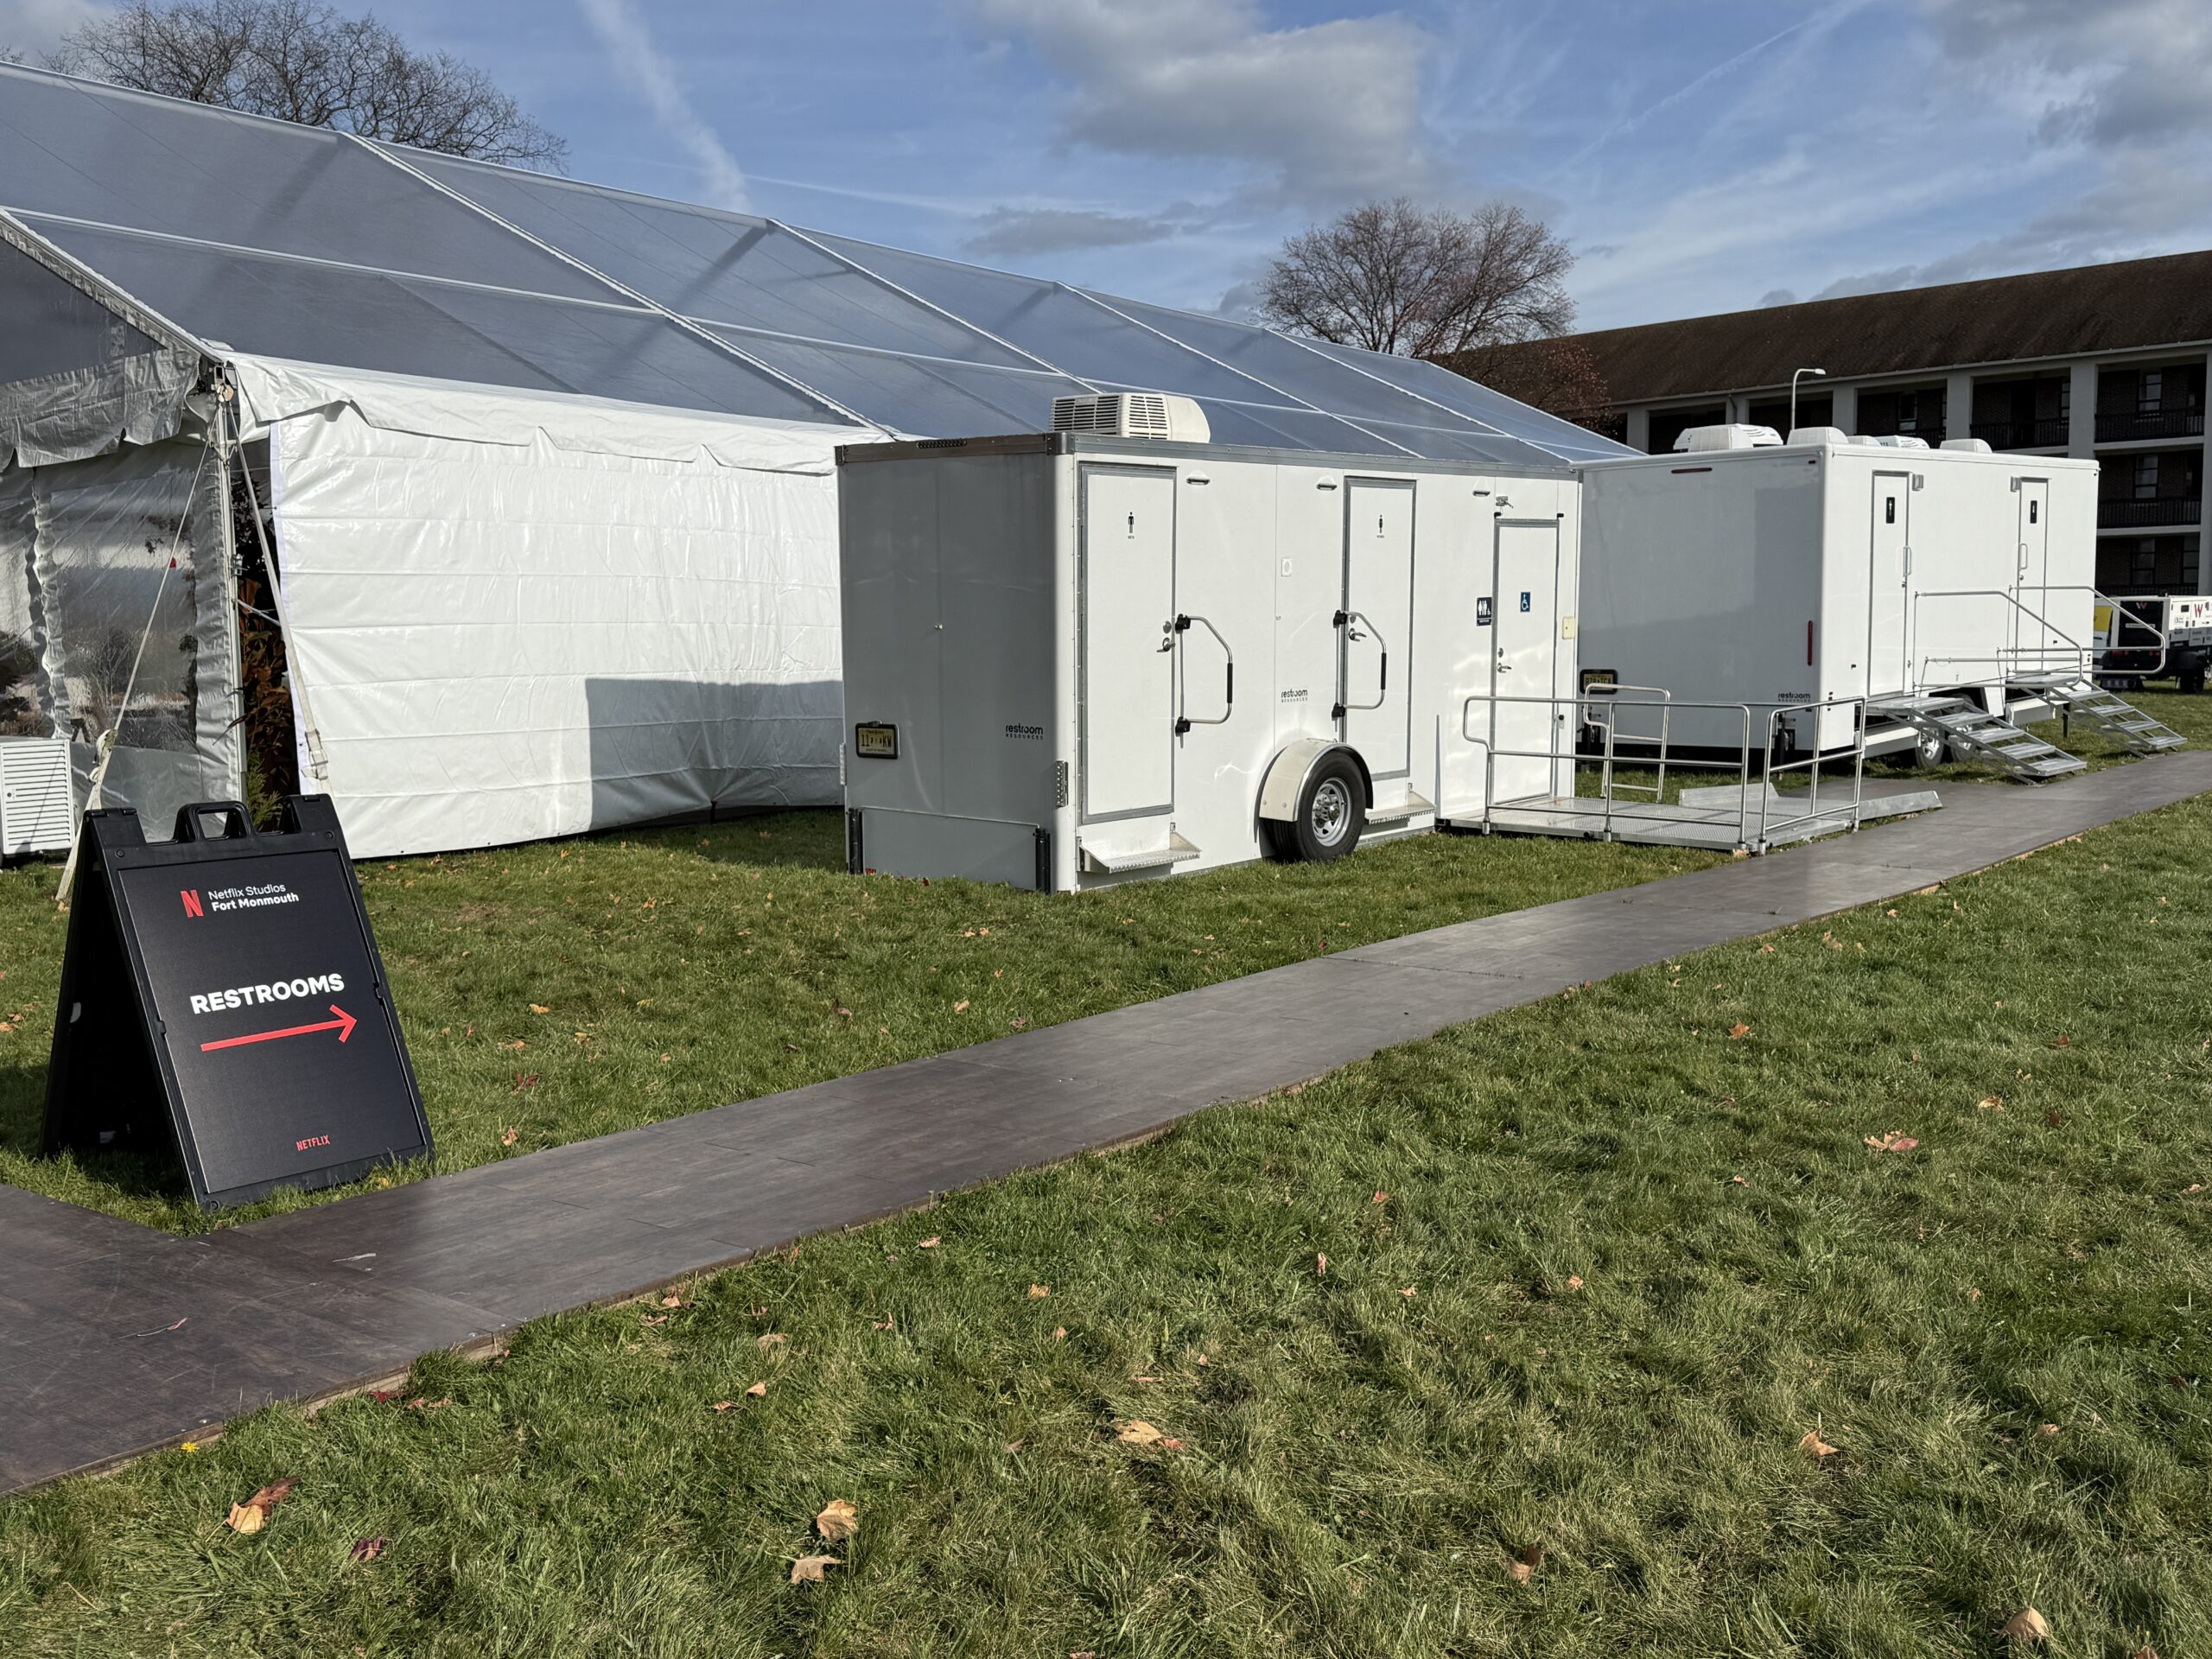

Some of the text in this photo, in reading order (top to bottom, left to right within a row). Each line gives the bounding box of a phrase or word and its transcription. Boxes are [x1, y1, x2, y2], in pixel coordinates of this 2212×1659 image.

[1006, 722, 1044, 734] restroom
[208, 883, 286, 900] Netflix Studios
[180, 889, 205, 918] N
[211, 892, 299, 912] Fort Monmouth
[190, 973, 345, 1014] RESTROOMS
[296, 1134, 331, 1152] NETFLIX
